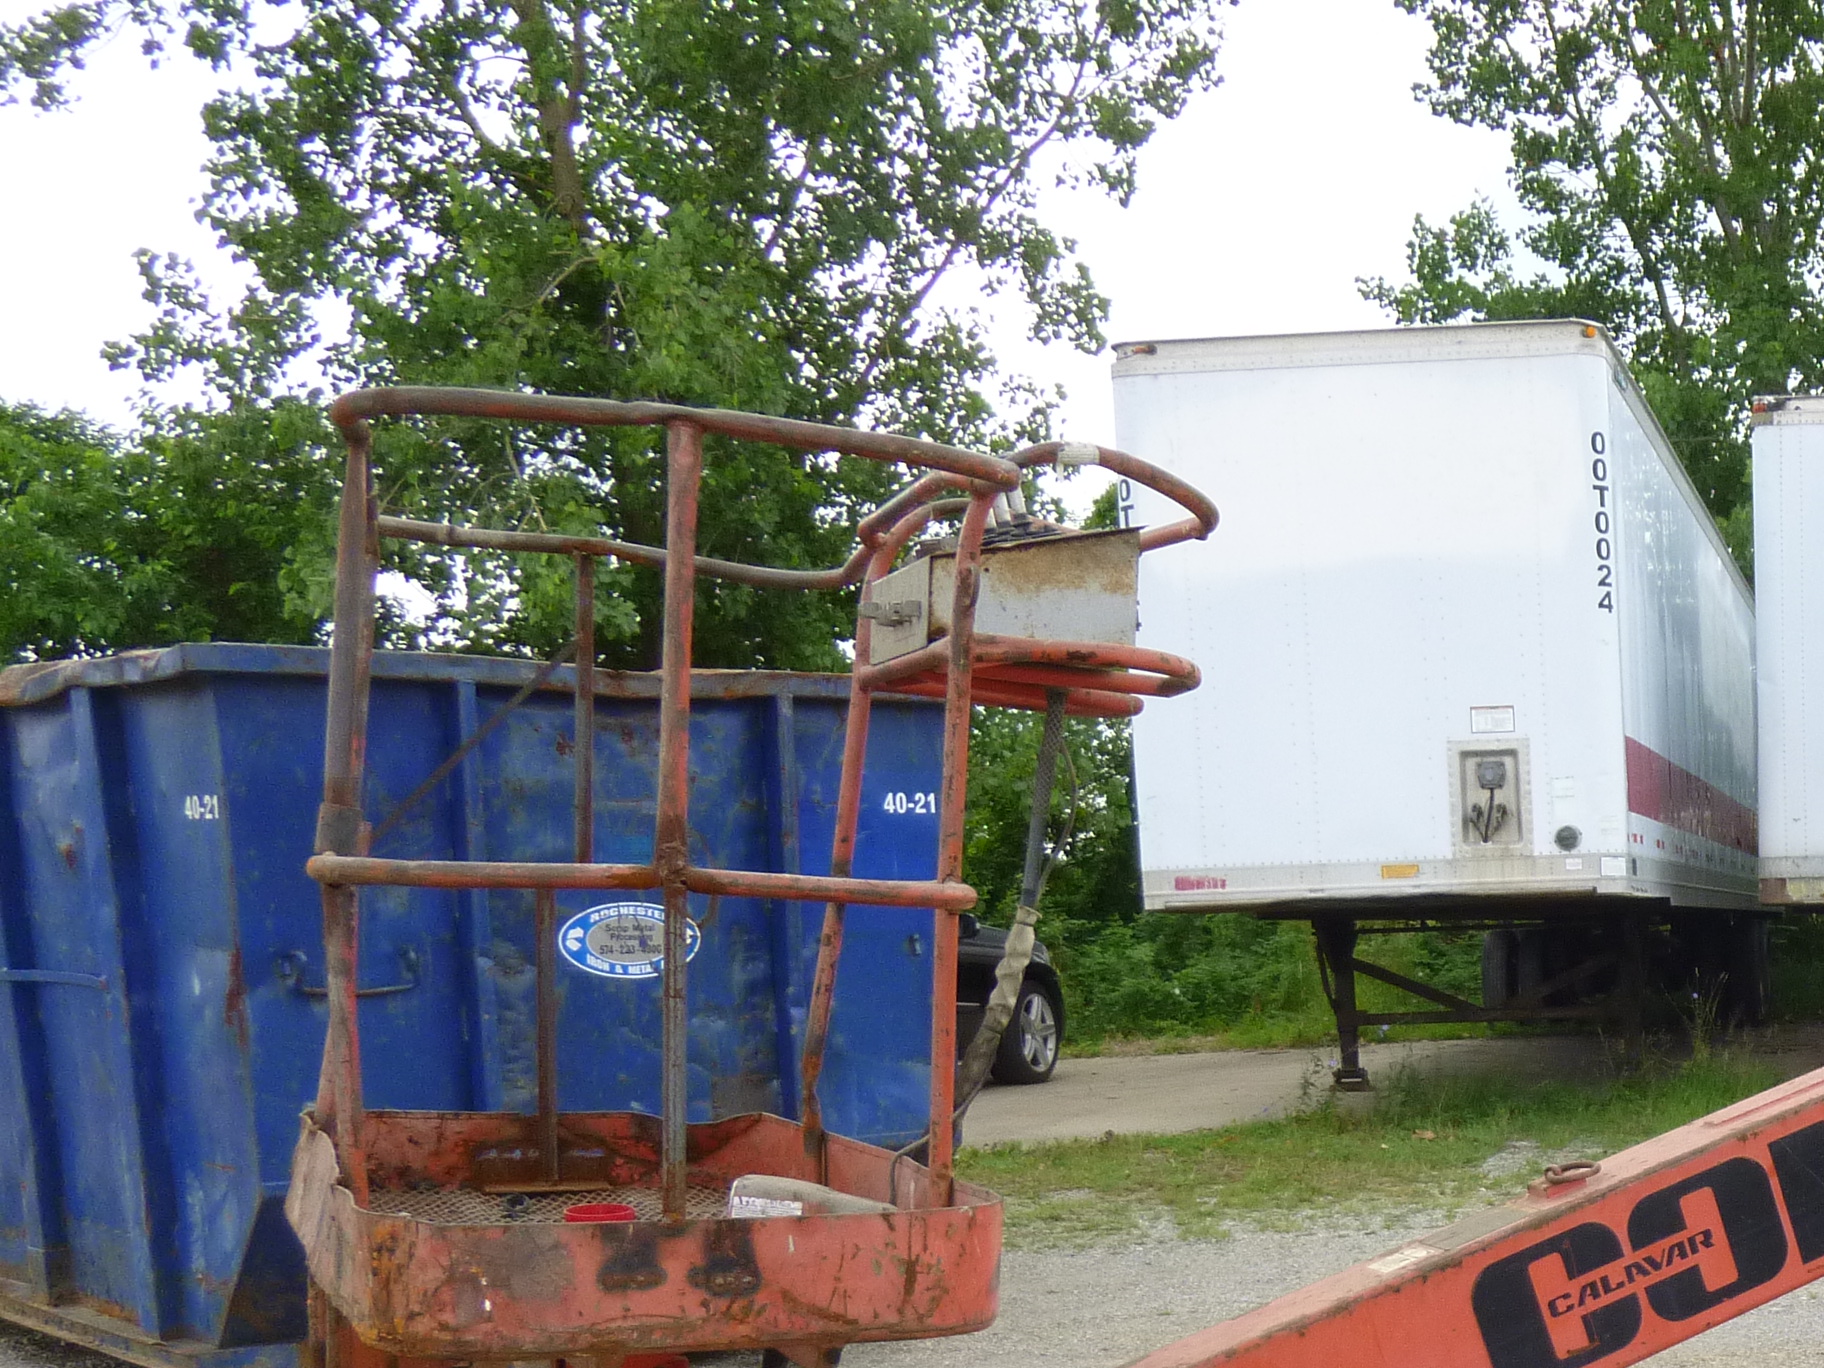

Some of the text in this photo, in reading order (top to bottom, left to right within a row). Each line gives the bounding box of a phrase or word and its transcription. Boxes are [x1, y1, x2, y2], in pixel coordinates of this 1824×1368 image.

[1590, 431, 1615, 614] 00T0024
[184, 794, 220, 820] 40-21
[883, 791, 937, 814] 40-21
[1547, 1227, 1715, 1319] CALAVAR
